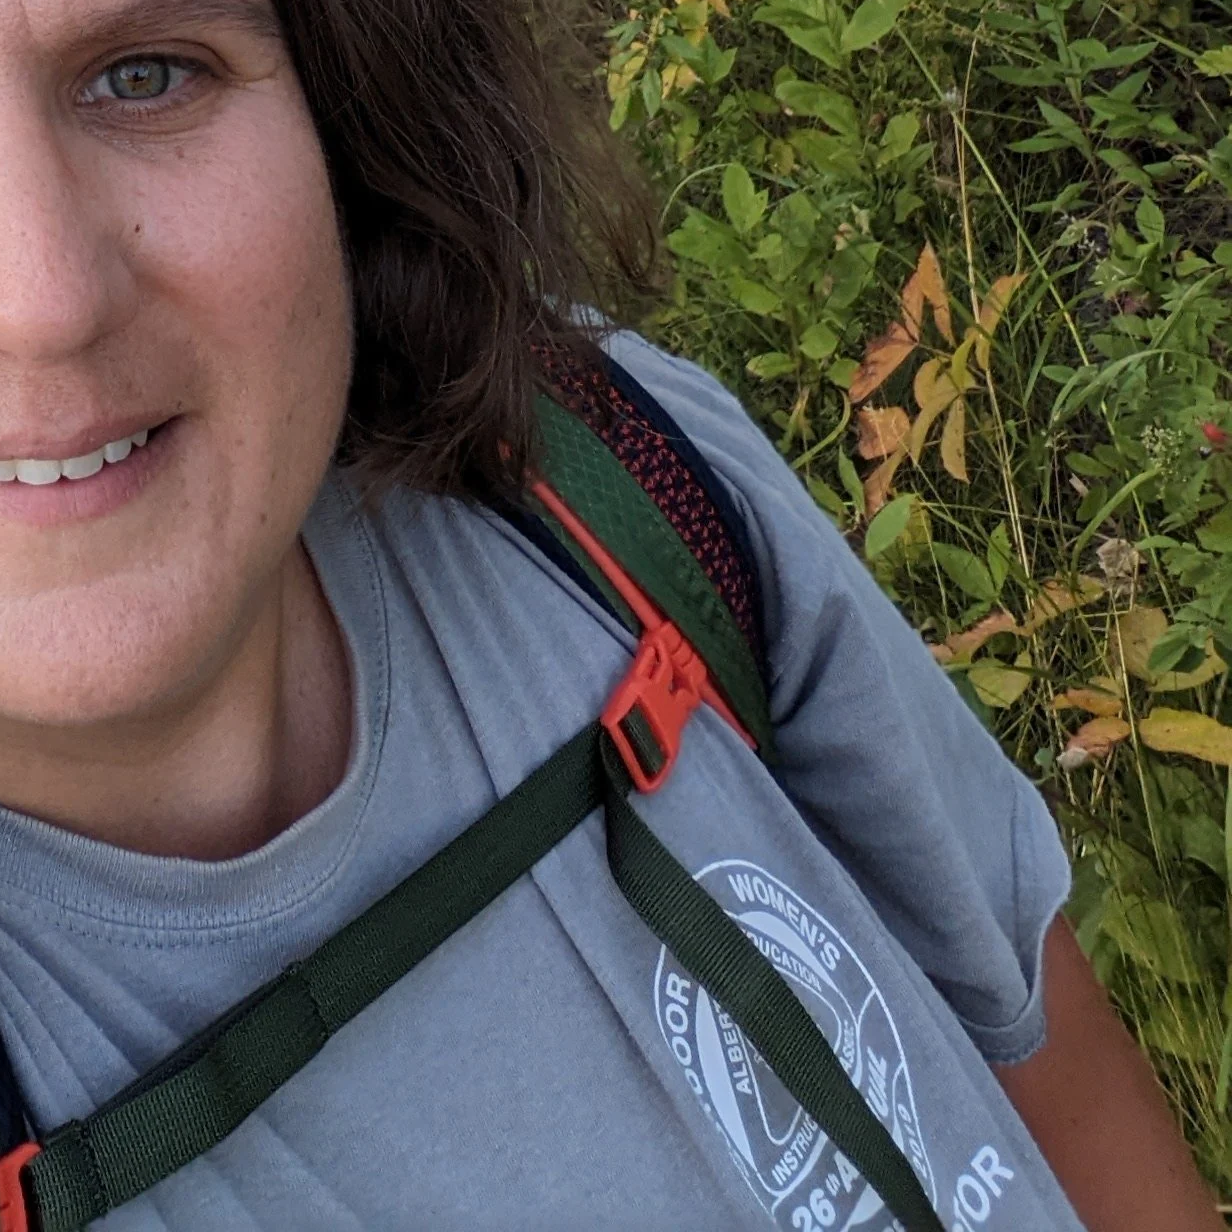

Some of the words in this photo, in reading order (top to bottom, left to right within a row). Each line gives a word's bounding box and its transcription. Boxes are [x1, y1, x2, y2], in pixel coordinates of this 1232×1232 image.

[728, 873, 841, 971] WOMEN'S
[741, 928, 822, 992] DUCATION
[713, 999, 753, 1096] ALBER
[771, 1113, 818, 1186] INSTRUC
